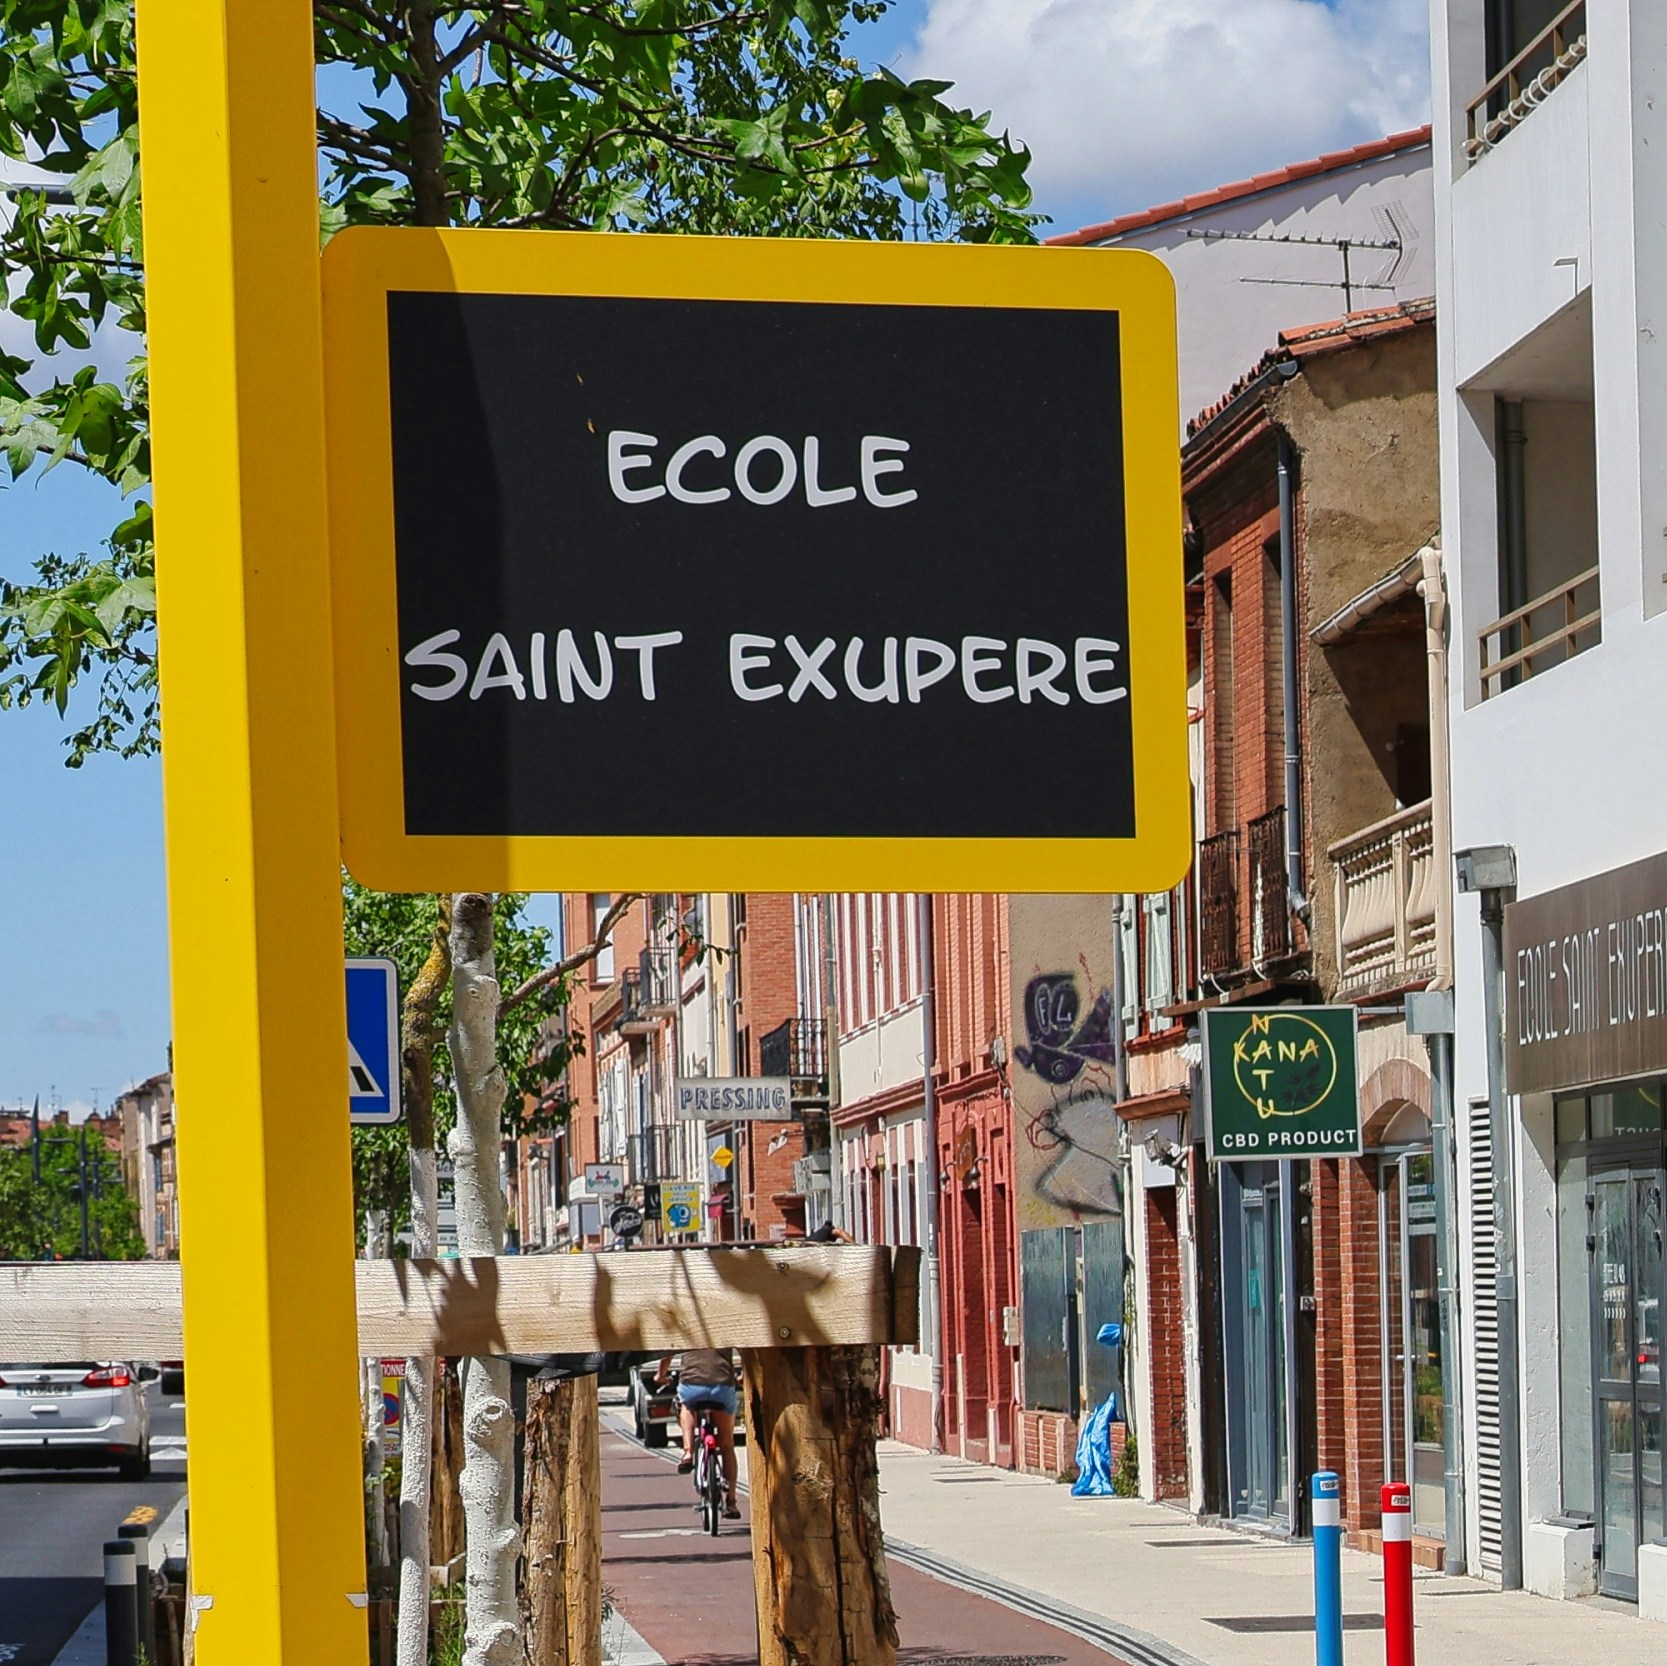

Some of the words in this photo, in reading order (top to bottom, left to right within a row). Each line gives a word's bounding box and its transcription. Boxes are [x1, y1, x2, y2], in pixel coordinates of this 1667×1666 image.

[607, 430, 918, 508] ECOLE
[404, 629, 683, 703] SAINT
[729, 634, 1128, 707] EXUPERE
[1517, 940, 1560, 1045] ECOLE
[1562, 927, 1601, 1036] SAINT
[1233, 1038, 1319, 1064] KANA
[680, 1087, 786, 1110] PRESSING
[1222, 1133, 1260, 1148] CBD
[1268, 1129, 1357, 1146] PRODUCT
